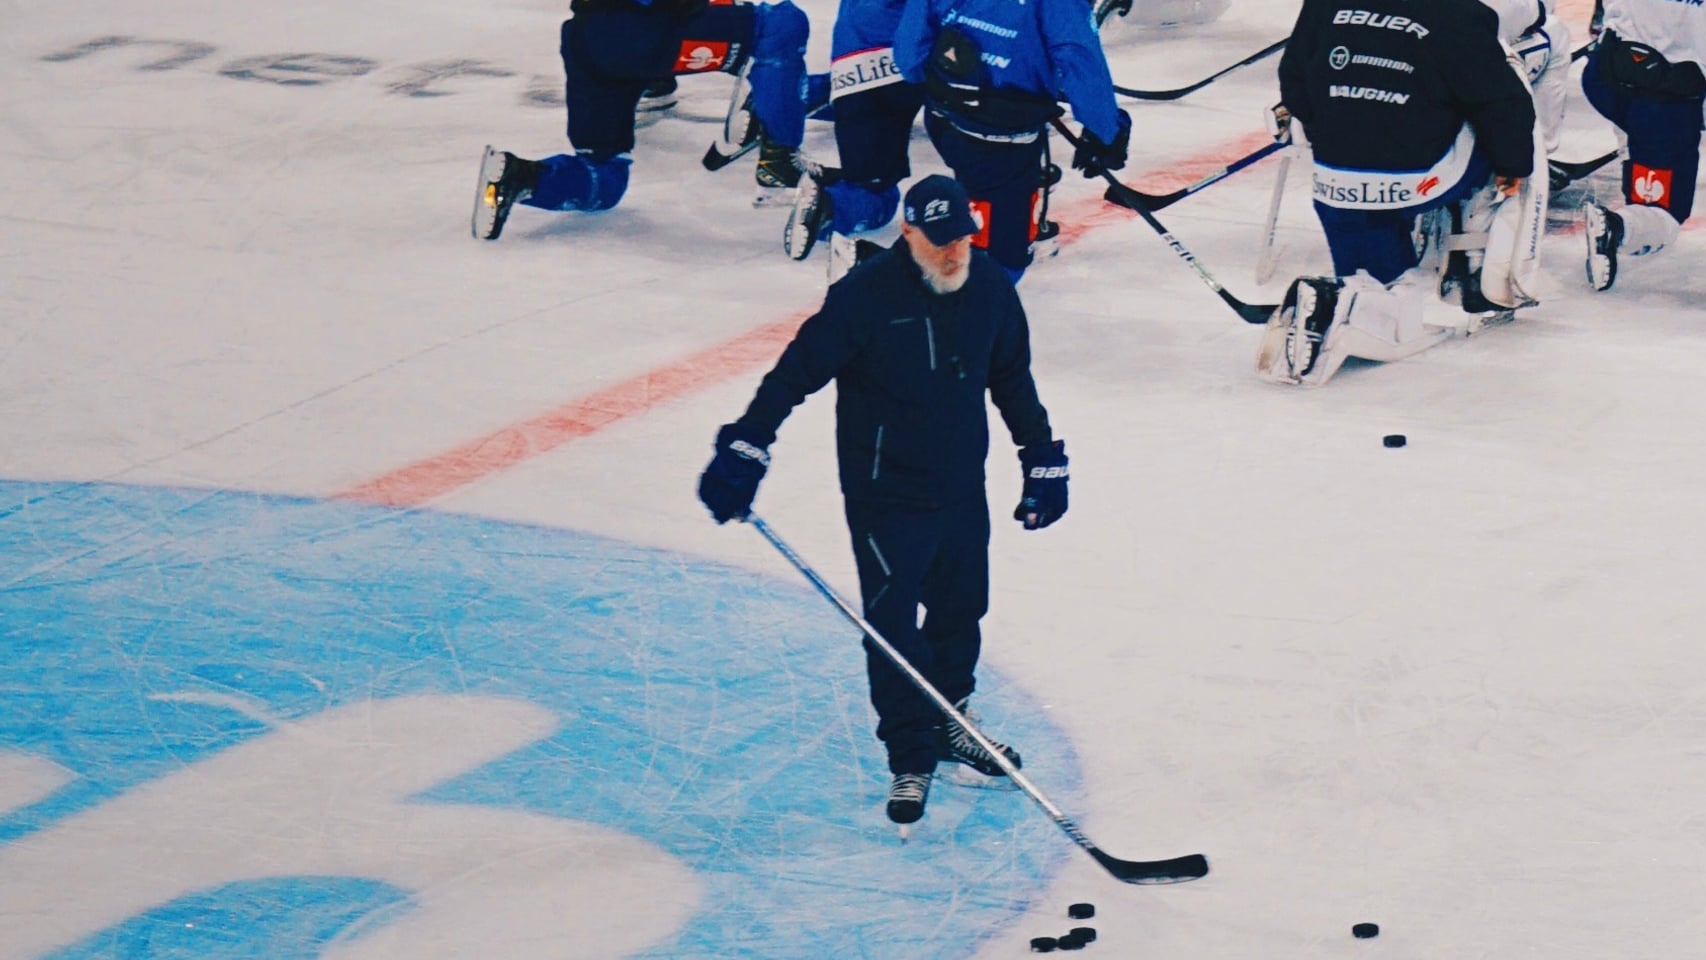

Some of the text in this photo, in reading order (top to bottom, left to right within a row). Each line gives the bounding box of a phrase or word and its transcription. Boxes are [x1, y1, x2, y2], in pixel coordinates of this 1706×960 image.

[1333, 9, 1430, 40] BAUER
[831, 54, 901, 91] issLife
[1329, 85, 1410, 105] VAUGHN
[729, 440, 771, 467] BAU
[1029, 465, 1070, 479] BAU
